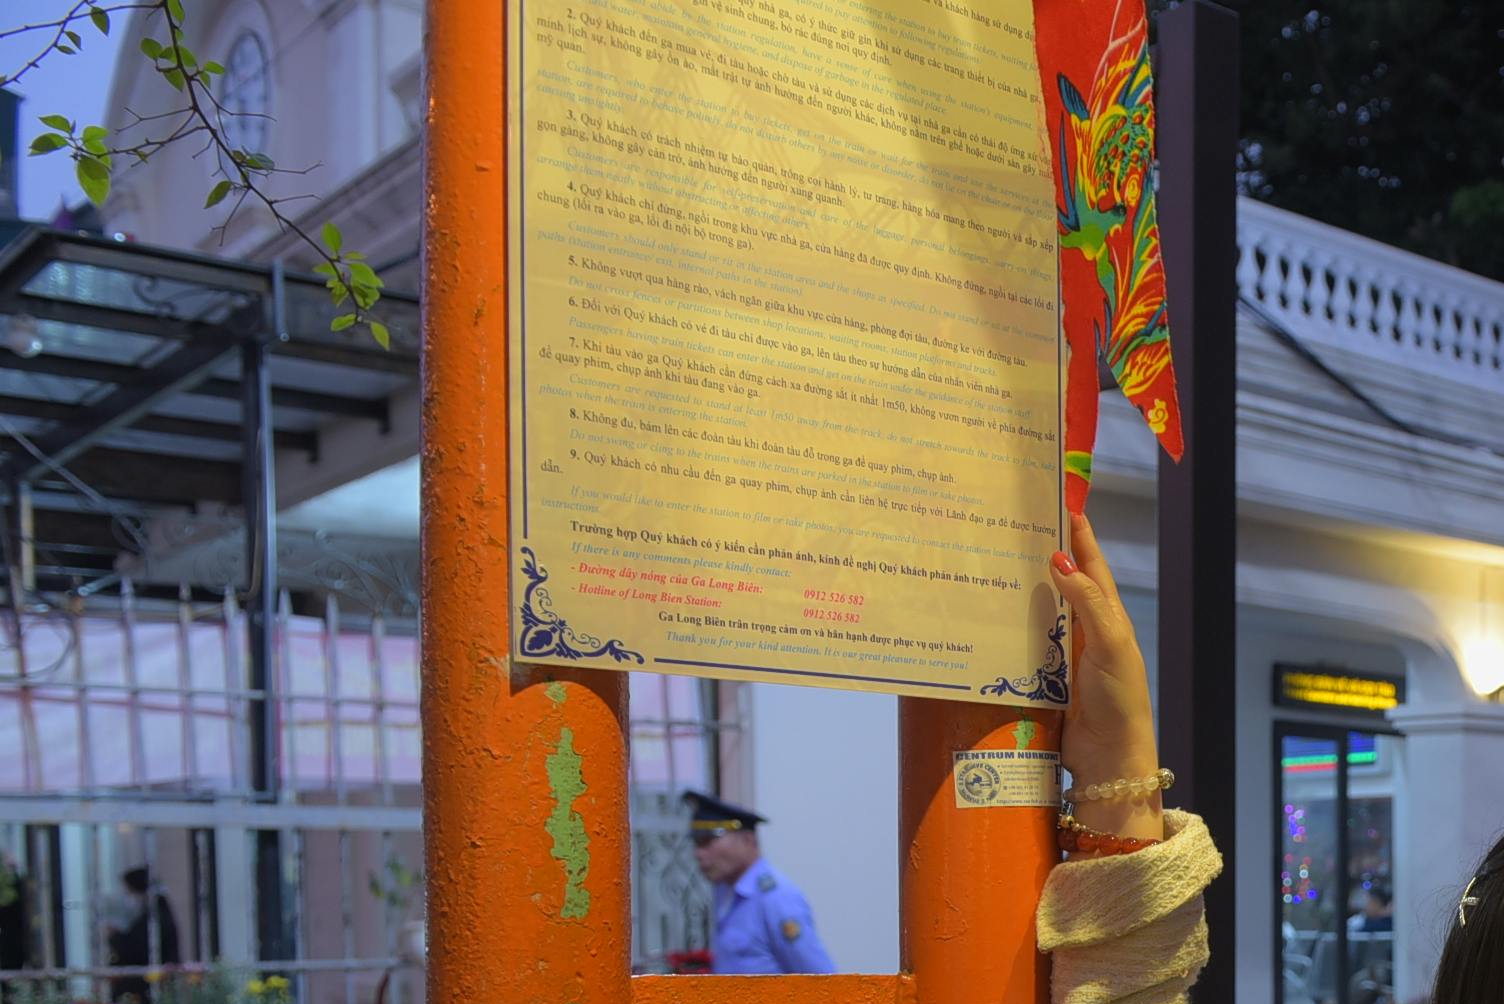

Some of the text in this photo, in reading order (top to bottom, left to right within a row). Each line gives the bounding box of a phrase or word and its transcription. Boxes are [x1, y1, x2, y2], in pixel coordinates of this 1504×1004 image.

[568, 255, 578, 267] 5.
[645, 274, 664, 286] qua
[787, 303, 805, 317] khu
[570, 408, 580, 420] 8.
[744, 437, 759, 450] khi
[817, 452, 840, 466] trong
[842, 457, 853, 468] ga
[867, 462, 889, 474] quay
[570, 449, 580, 460] 9.
[661, 463, 679, 476] nhu
[725, 476, 736, 487] ga
[740, 478, 762, 490] quay
[986, 518, 996, 528] ga
[570, 520, 613, 539] Trường
[616, 526, 637, 542] hợp
[640, 530, 664, 545] Quý
[666, 533, 698, 547] khách
[701, 538, 713, 549] có
[715, 540, 721, 553] ý
[724, 540, 745, 553] kiến
[748, 542, 765, 556] cần
[819, 554, 840, 566] kính
[842, 555, 854, 568] đề
[856, 560, 877, 573] nghị
[879, 562, 898, 576] Quý
[900, 565, 927, 577] khách
[954, 572, 970, 583] ánh
[972, 576, 990, 587] trực
[991, 576, 1008, 590] tiếp
[571, 541, 582, 554] If
[583, 544, 609, 555] there
[623, 550, 640, 561] any
[643, 554, 691, 565] comments
[693, 557, 723, 569] please
[726, 561, 753, 575] kindly
[755, 567, 792, 577] contact:
[578, 583, 860, 624] Hotline of Long Bien Station: 0912 526 582
[691, 576, 706, 587] Ga
[709, 578, 734, 593] Long
[804, 589, 826, 601] 0912
[829, 592, 846, 604] 526
[847, 595, 864, 606] 582
[658, 611, 673, 622] Ga
[676, 613, 702, 627] Long
[704, 616, 726, 627] Biên
[728, 619, 749, 630] trân
[751, 622, 777, 634] trọng
[800, 628, 812, 636] ơn
[814, 628, 825, 638] và
[827, 629, 843, 640] hân
[845, 631, 868, 643] hạnh
[870, 634, 893, 646] được
[893, 637, 914, 649] phục
[916, 641, 927, 650] vụ
[928, 641, 944, 652] quý
[946, 642, 974, 653] khách!
[666, 631, 696, 643] Thank
[698, 636, 716, 646] you
[718, 636, 733, 649] for
[735, 640, 756, 649] your
[758, 641, 779, 652] kind
[842, 651, 858, 659] our
[858, 653, 880, 662] great
[882, 654, 917, 665] pleasure
[928, 660, 949, 669] serve
[949, 662, 968, 670] you!
[955, 751, 1015, 760] CENTRUM
